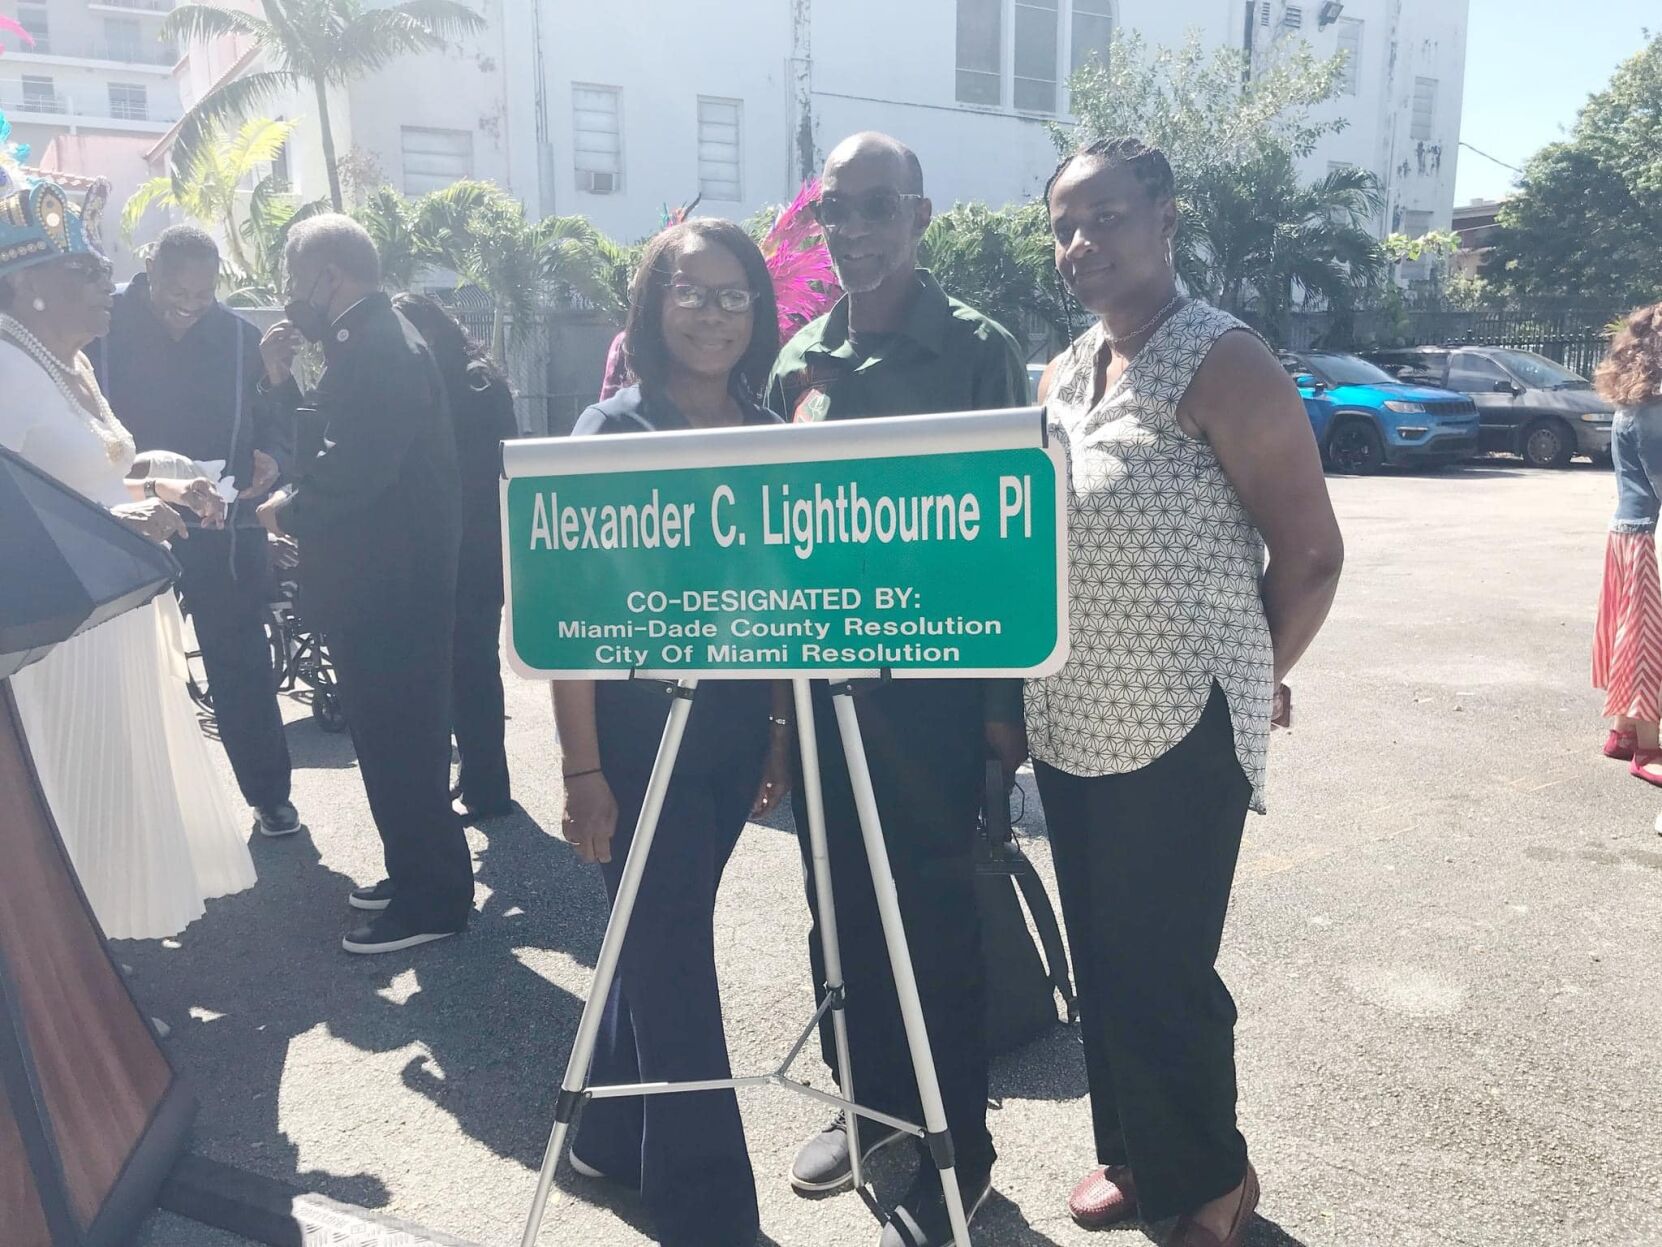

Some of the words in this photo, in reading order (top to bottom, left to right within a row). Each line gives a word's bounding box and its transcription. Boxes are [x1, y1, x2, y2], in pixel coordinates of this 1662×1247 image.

[530, 488, 695, 550] Alexander
[711, 484, 746, 548] C.
[762, 481, 980, 560] Lightbourne
[999, 475, 1032, 538] Pl
[626, 588, 862, 613] CO-DESIGNATED
[875, 587, 920, 609] BY:
[558, 618, 718, 638] Miami-Dade
[730, 617, 830, 640] County
[844, 616, 1001, 636] Resolution
[595, 645, 648, 667] City
[661, 644, 693, 663] Of
[707, 644, 788, 663] Miami
[802, 643, 960, 662] Resolution
